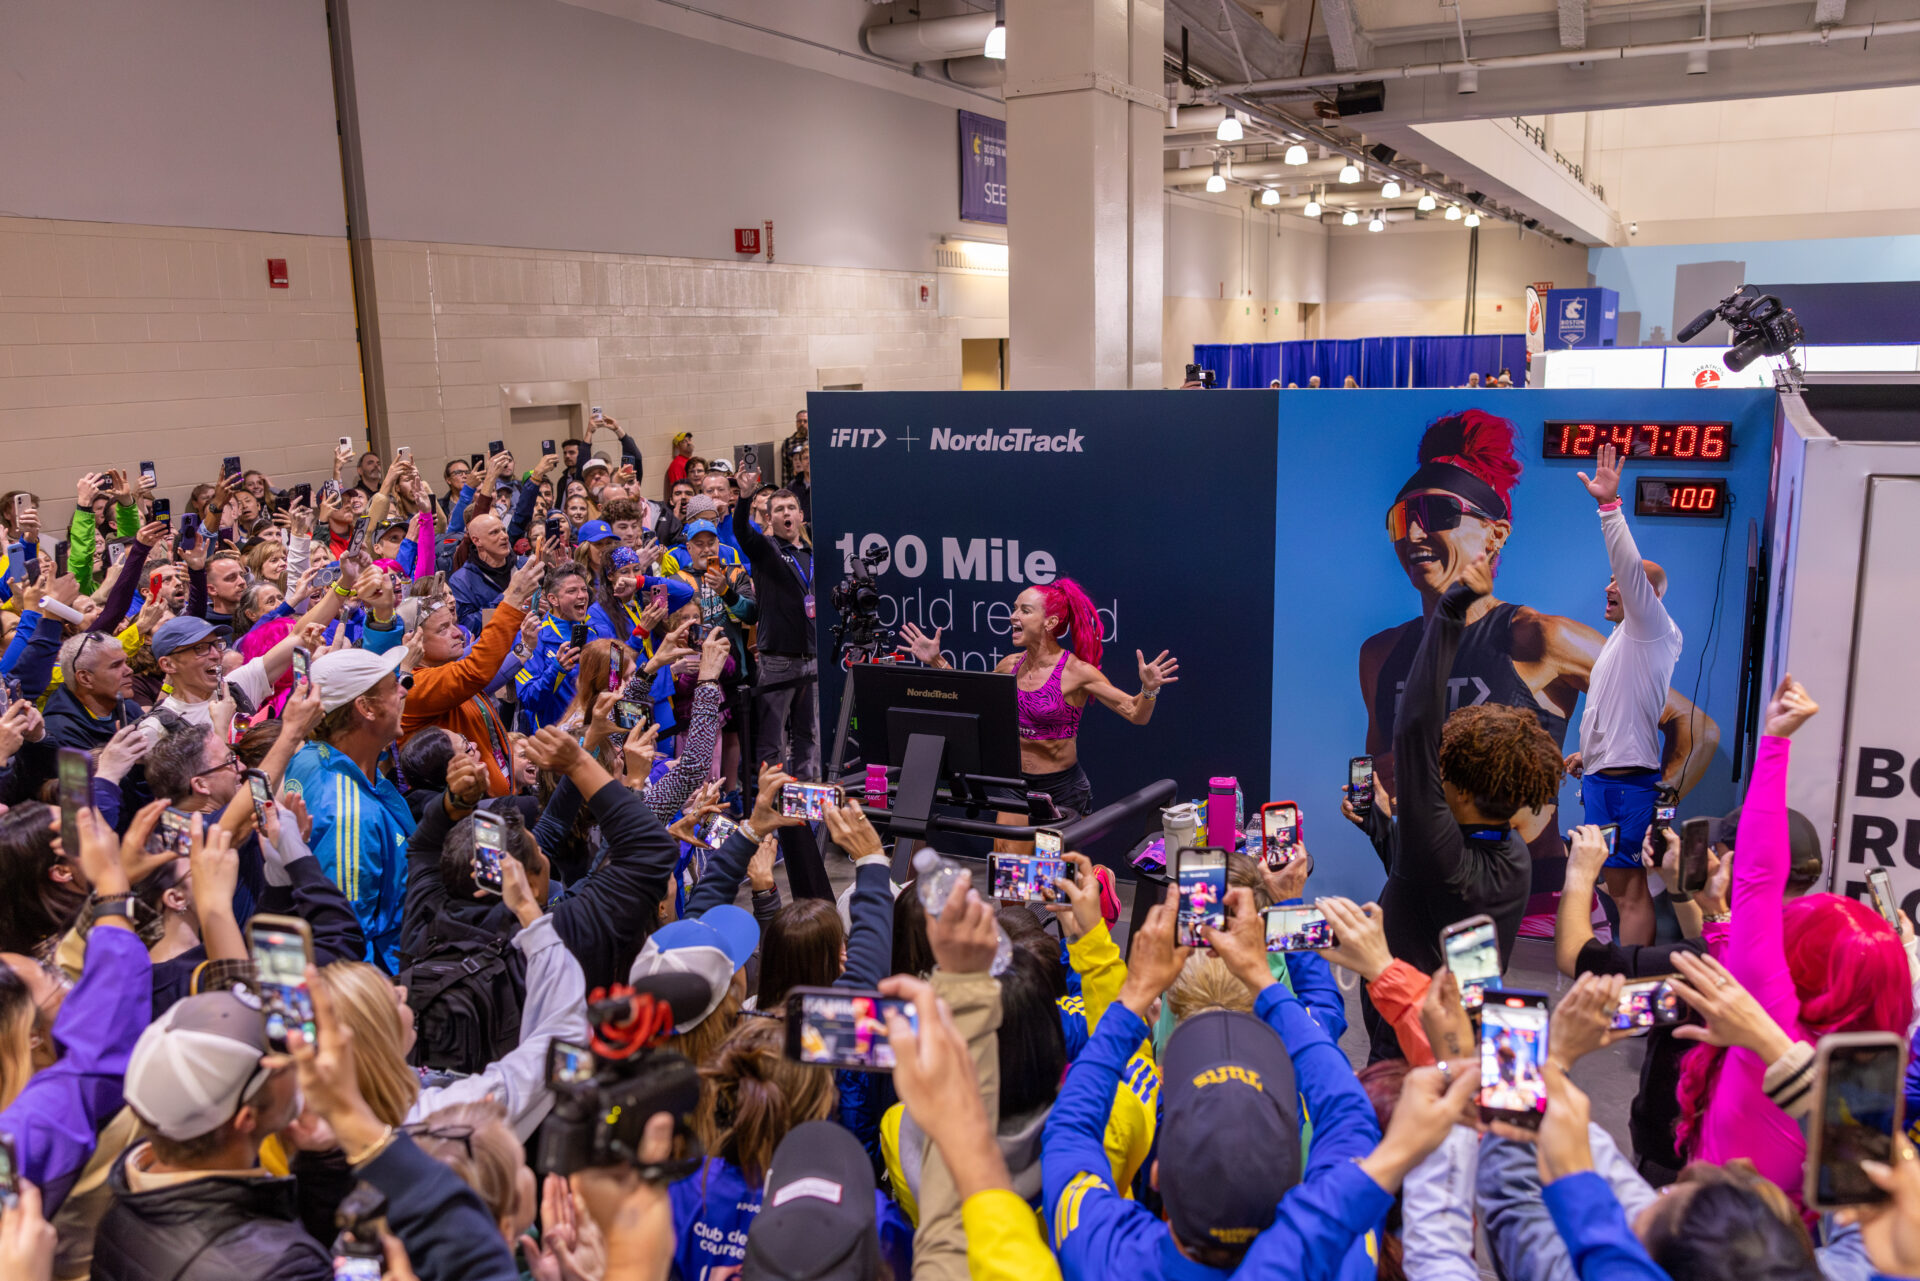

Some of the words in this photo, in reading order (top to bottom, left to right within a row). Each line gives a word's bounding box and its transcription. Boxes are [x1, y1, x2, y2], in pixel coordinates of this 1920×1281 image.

[984, 182, 1006, 205] SEE
[930, 427, 1085, 453] NordicTrack
[1561, 424, 1725, 458] 12:47:06
[1671, 487, 1716, 509] 100
[835, 532, 928, 579] 100
[942, 537, 1057, 585] Mile
[846, 587, 953, 631] orld
[906, 687, 959, 700] NordicTrack
[694, 1221, 724, 1243] Club
[727, 1229, 749, 1246] de
[700, 1238, 746, 1259] course
